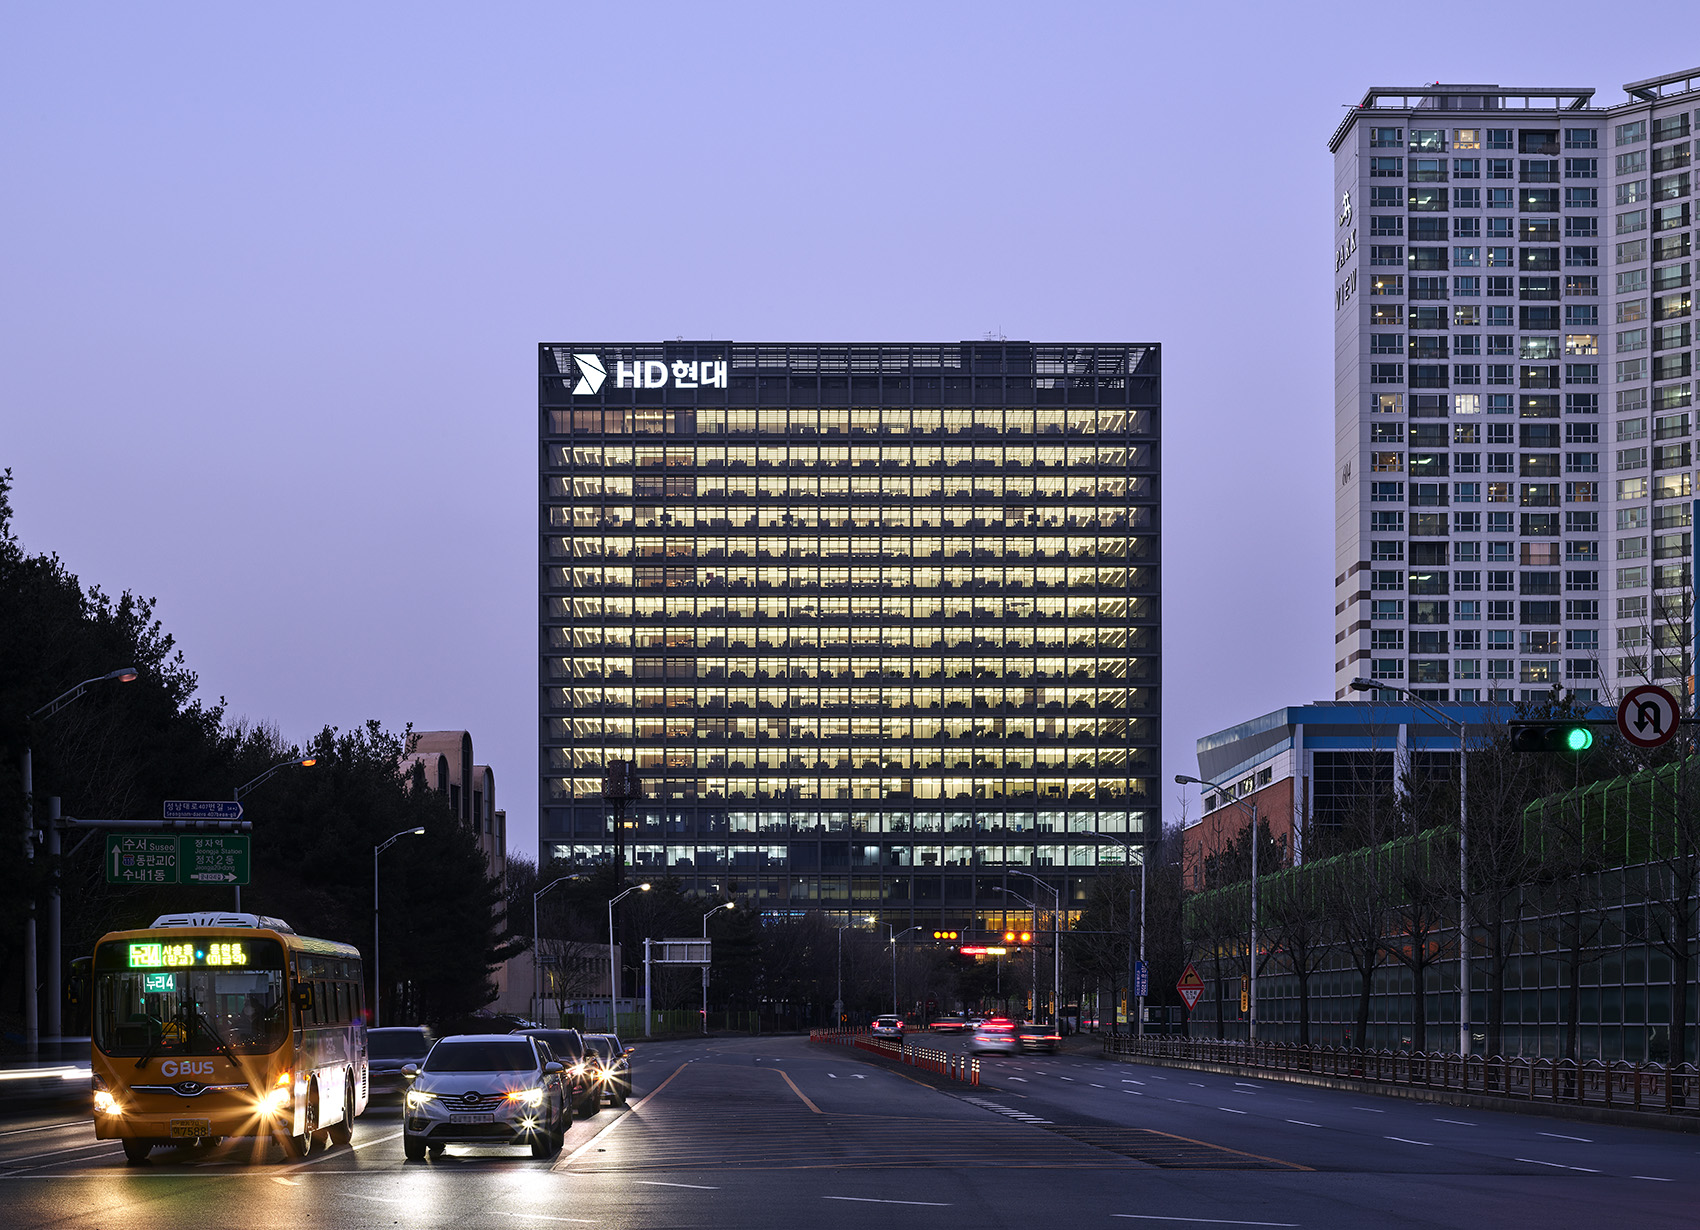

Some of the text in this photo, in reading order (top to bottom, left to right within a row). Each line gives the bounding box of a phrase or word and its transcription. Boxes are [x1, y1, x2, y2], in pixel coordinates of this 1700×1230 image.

[1336, 228, 1357, 273] PARK
[1336, 268, 1357, 311] VIEW
[616, 359, 728, 389] HD 현대
[123, 838, 175, 851] 수서 Suseo
[195, 838, 224, 848] 정자역
[220, 847, 243, 855] Station
[136, 854, 176, 867] 동판교IC
[122, 868, 166, 882] 수내1동
